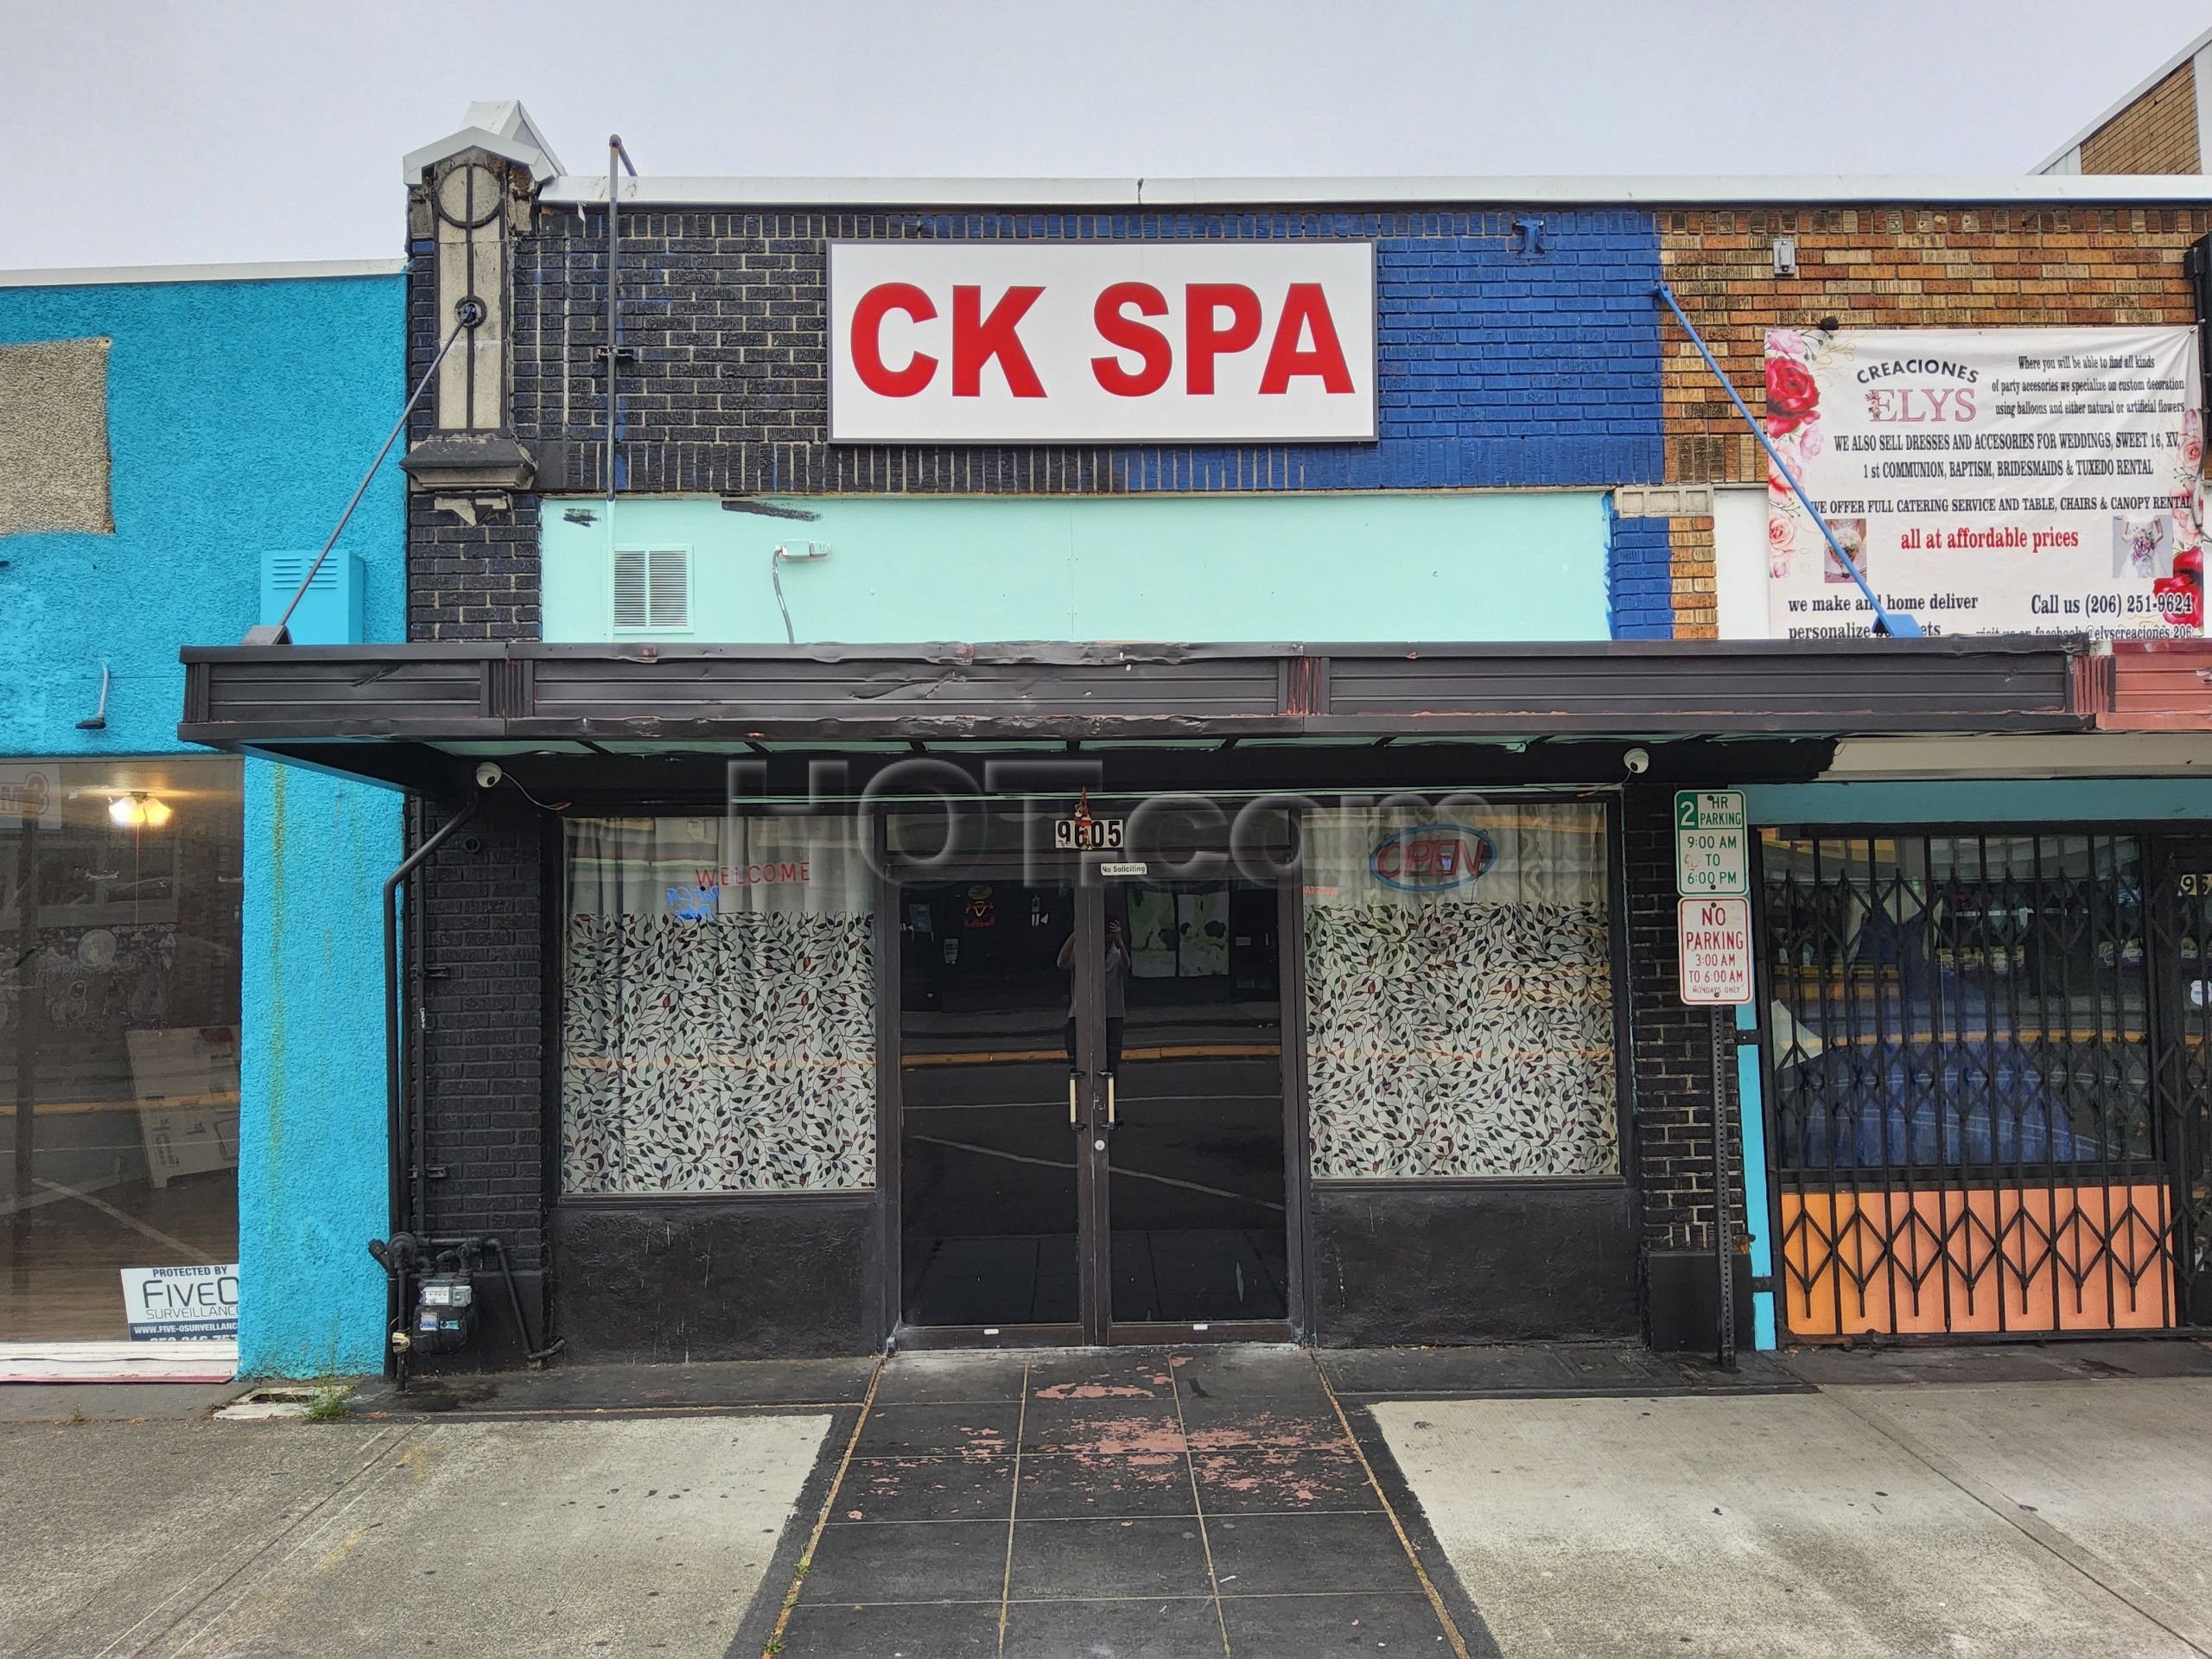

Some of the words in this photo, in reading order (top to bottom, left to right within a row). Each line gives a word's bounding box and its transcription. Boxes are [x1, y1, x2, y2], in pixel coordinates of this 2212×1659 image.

[850, 282, 1048, 397] CK
[1090, 282, 1357, 397] SPA
[1856, 359, 1980, 384] CREACIONES
[2018, 356, 2040, 369] Where
[2043, 359, 2056, 372] you
[2057, 355, 2071, 369] will
[2072, 356, 2081, 369] be
[2083, 355, 2098, 369] able
[2100, 356, 2107, 368] to
[2109, 354, 2122, 369] find
[2124, 354, 2133, 368] all
[2135, 354, 2155, 368] kinds
[1992, 378, 1999, 391] of
[2001, 378, 2020, 396] party
[2022, 378, 2058, 391] accesories
[2061, 381, 2069, 391] we
[2071, 377, 2106, 395] specialize
[2108, 381, 2116, 391] on
[2119, 378, 2145, 391] custom
[2147, 377, 2184, 391] decoration
[1866, 387, 1977, 423] ELYS
[1995, 401, 2015, 418] using
[2018, 401, 2047, 415] balloons
[2050, 401, 2063, 415] and
[2065, 401, 2086, 414] either
[2088, 400, 2114, 414] natural
[2116, 404, 2124, 414] or
[2126, 398, 2156, 413] artificial
[2158, 399, 2185, 413] flowers
[1834, 435, 1849, 452] WE
[1852, 435, 1877, 451] ALSO
[1879, 435, 1904, 451] SELL
[1905, 434, 1950, 451] DRESSES
[1953, 434, 1972, 450] AND
[1974, 433, 2034, 450] ACCESORIES
[2037, 433, 2056, 449] FOR
[2059, 432, 2113, 450] WEDDINGS,
[2116, 431, 2147, 448] SWEET
[2151, 432, 2164, 450] 16,
[2165, 431, 2180, 449] XV,
[1871, 463, 1880, 479] st
[1883, 461, 1947, 480] COMMUNION,
[1949, 461, 1995, 480] BAPTISM,
[1997, 460, 2063, 477] BRIDESMAIDS
[2066, 460, 2074, 476] &
[2075, 459, 2114, 475] TUXEDO
[2117, 459, 2153, 475] RENTAL
[1829, 500, 1865, 514] OFFER
[1867, 499, 1893, 513] FULL
[1897, 499, 1948, 513] CATERING
[1952, 499, 1996, 512] SERVICE
[1999, 498, 2019, 512] AND
[2022, 498, 2057, 512] TABLE,
[2060, 497, 2097, 511] CHAIRS
[2101, 496, 2108, 510] &
[2111, 496, 2150, 510] CANOPY
[2152, 496, 2192, 510] RENTAL
[1901, 528, 1921, 550] all
[1926, 528, 1942, 549] at
[1948, 526, 2027, 549] affordable
[2032, 526, 2079, 554] prices
[1789, 600, 1808, 612] we
[1812, 594, 1851, 611] make
[1886, 594, 1925, 610] home
[1929, 593, 1978, 609] deliver
[2031, 594, 2059, 614] Call
[2063, 598, 2080, 613] us
[2085, 594, 2122, 618] (206)
[2127, 593, 2192, 614] 251-9624
[1789, 622, 1871, 639] personalize
[2173, 625, 2192, 639] 206
[1681, 800, 1695, 826] 2
[1712, 796, 1728, 809] HR
[1700, 812, 1741, 825] PARKING
[1058, 820, 1122, 849] 9605
[1687, 836, 1715, 849] 9:00
[1719, 836, 1737, 849] AM
[1377, 839, 1484, 878] OPEN
[1706, 853, 1720, 867] TO
[695, 861, 810, 887] WELCOME
[1113, 865, 1146, 874] Soliciting
[1687, 871, 1715, 885] 6:00
[1719, 871, 1737, 884] PM
[1701, 907, 1726, 926] NO
[1686, 931, 1744, 950] PARKING
[1695, 953, 1718, 967] 3:00
[1720, 953, 1736, 967] AM
[1688, 969, 1700, 983] TO
[1704, 969, 1726, 983] 6:00
[1729, 969, 1743, 982] AM
[153, 1267, 211, 1277] PROTECTED
[214, 1266, 227, 1274] BY
[146, 1305, 238, 1320] SURVEILLANC
